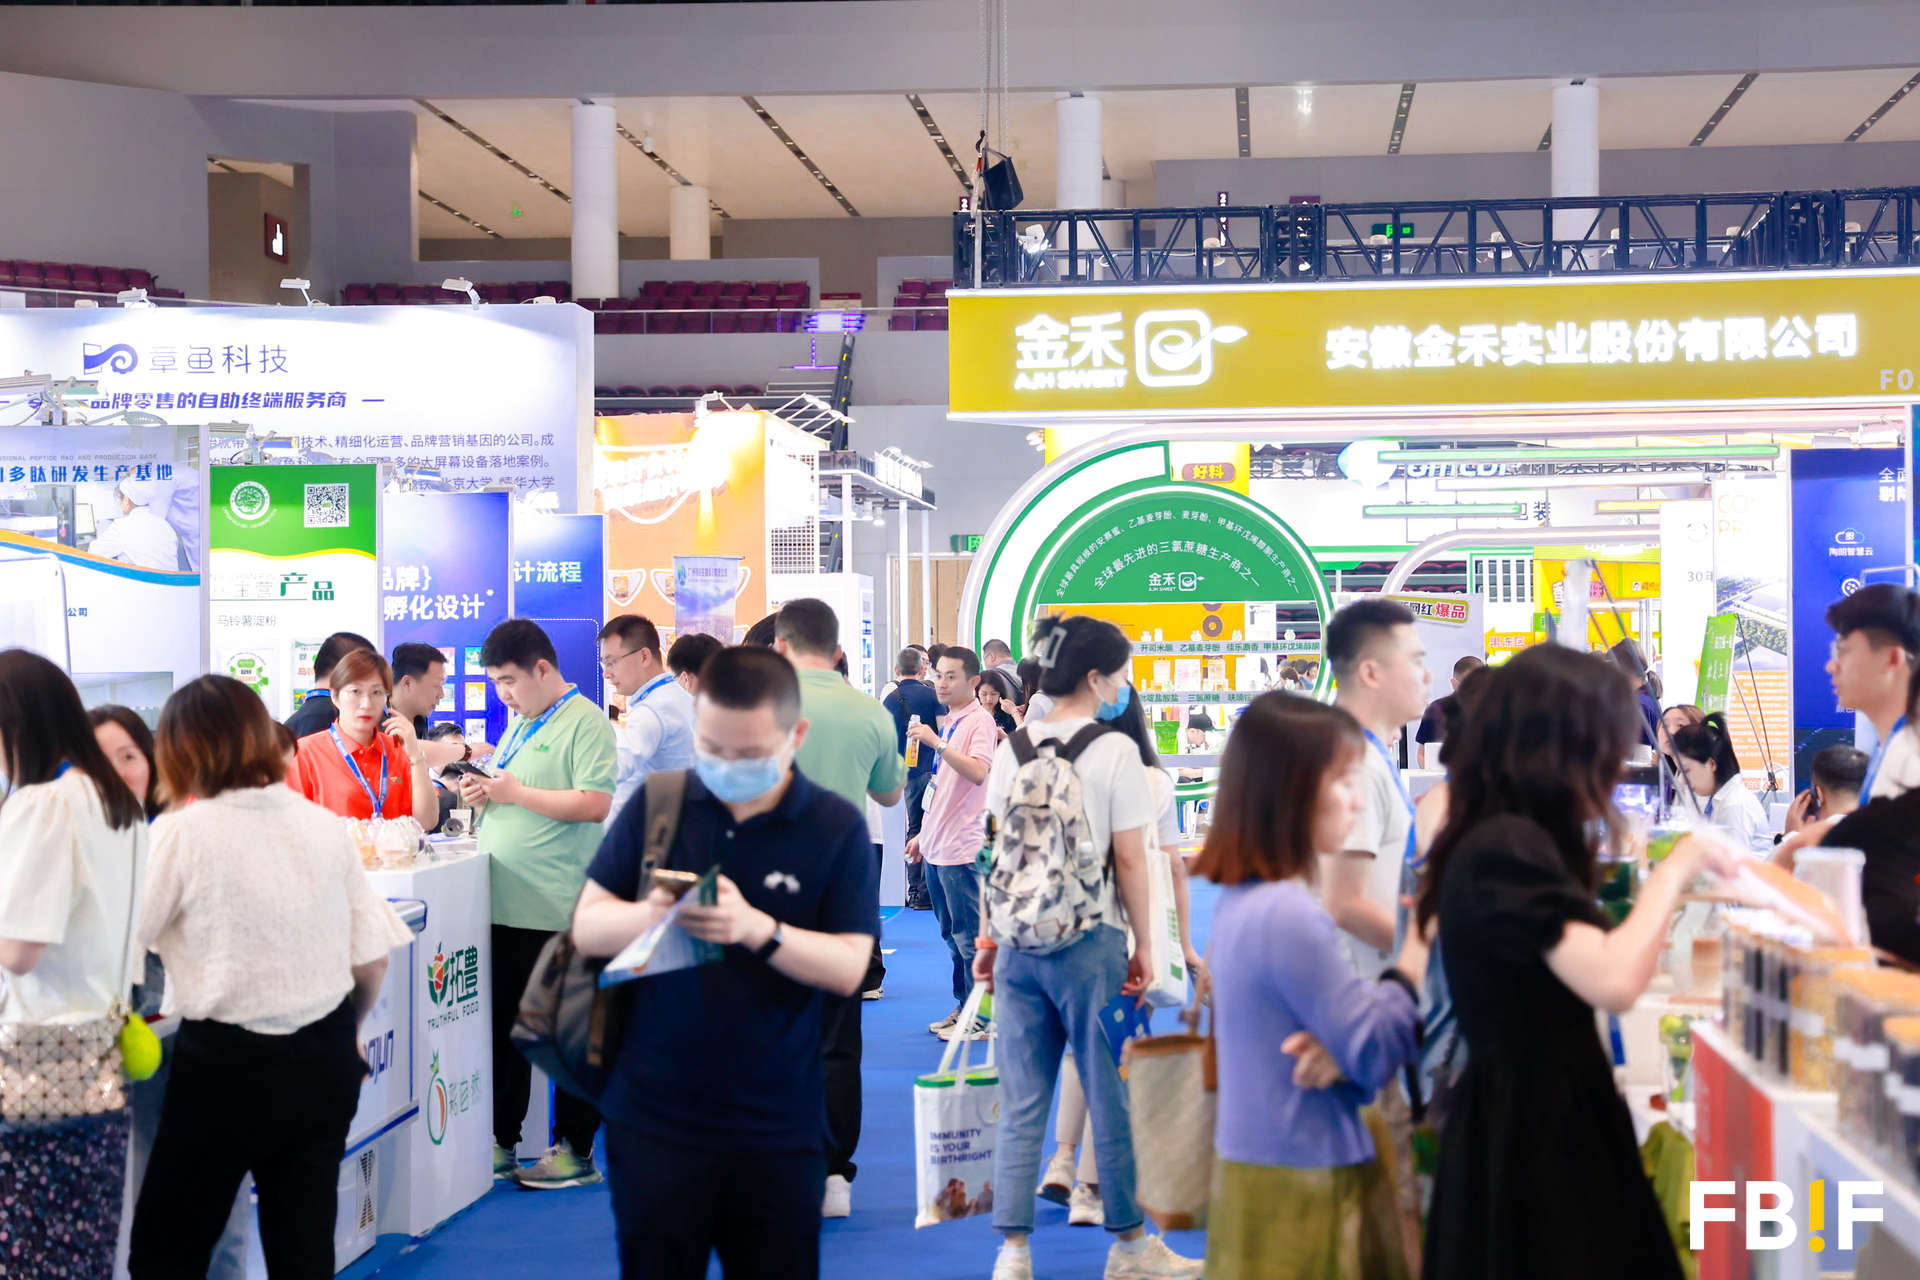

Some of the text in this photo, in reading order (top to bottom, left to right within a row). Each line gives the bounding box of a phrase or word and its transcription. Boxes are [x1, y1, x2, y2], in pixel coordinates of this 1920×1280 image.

[1014, 311, 1126, 370] 金禾
[1325, 313, 1858, 370] 安徽金禾实业股份有限公司
[149, 345, 289, 374] 章鱼科技
[0, 464, 173, 483] 多肽研发生产基地
[1148, 572, 1176, 586] 金禾
[384, 594, 485, 621] 孵化设计
[463, 1000, 480, 1017] FOOD
[930, 1128, 982, 1141] IMMUNITY
[930, 1141, 971, 1154] IS YOUR
[930, 1149, 993, 1165] BIRTHRIGHT
